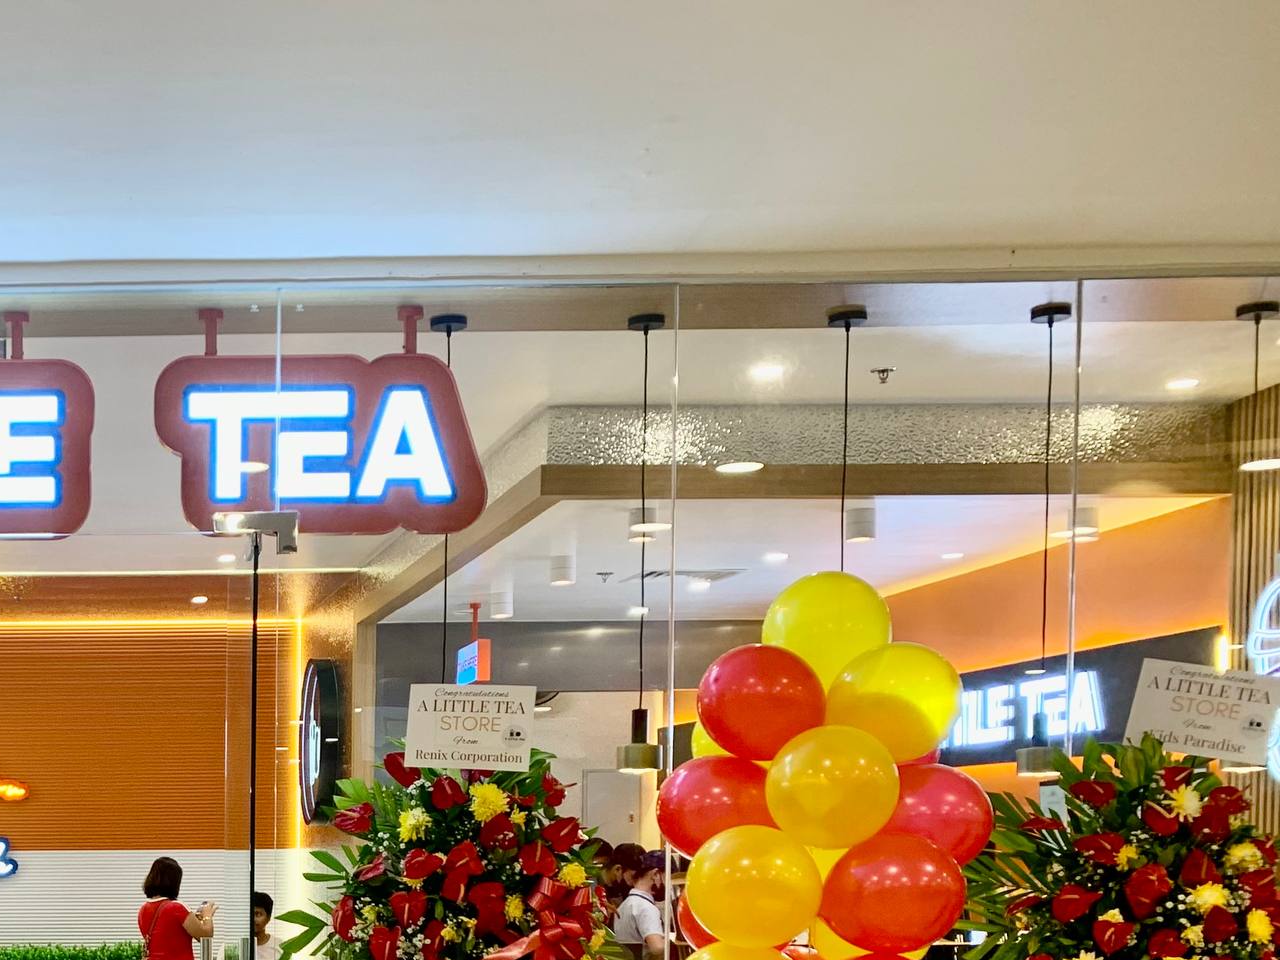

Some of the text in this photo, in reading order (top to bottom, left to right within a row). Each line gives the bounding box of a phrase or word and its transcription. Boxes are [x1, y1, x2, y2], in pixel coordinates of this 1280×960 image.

[183, 384, 457, 503] TEA
[1147, 676, 1271, 705] A LITTLE TEA
[417, 699, 525, 715] A LITTLE TEA
[1020, 670, 1105, 740] TEA
[1170, 696, 1241, 720] STORE
[440, 716, 501, 733] STORE
[1183, 734, 1246, 753] Paradise
[415, 750, 523, 764] Renix Corporation
